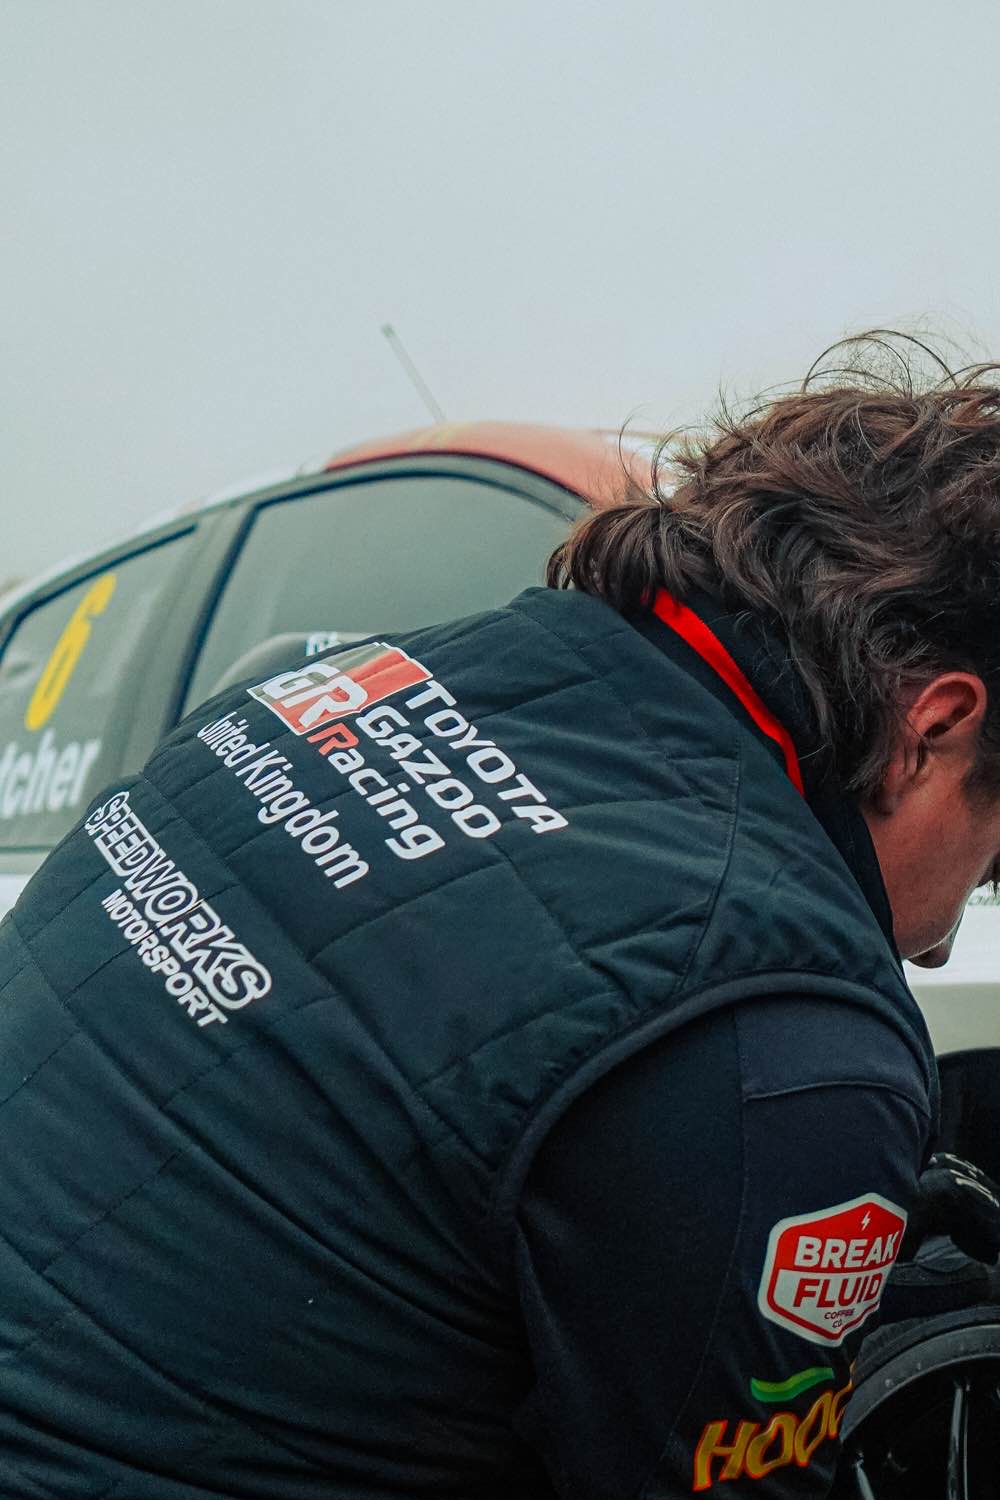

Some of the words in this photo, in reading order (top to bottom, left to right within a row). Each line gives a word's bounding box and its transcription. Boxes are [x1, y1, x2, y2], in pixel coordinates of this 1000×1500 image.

[25, 573, 117, 731] 6
[197, 711, 271, 768] United
[235, 750, 369, 889] Kingdom
[306, 722, 445, 859] Racing
[355, 705, 501, 838] GAZOO
[405, 680, 569, 833] TOYOTA
[85, 791, 272, 1010] SPEEDWORKS
[101, 889, 228, 1027] MOTORSPORT
[793, 1273, 883, 1308] FLUID
[794, 1231, 899, 1268] BREAK
